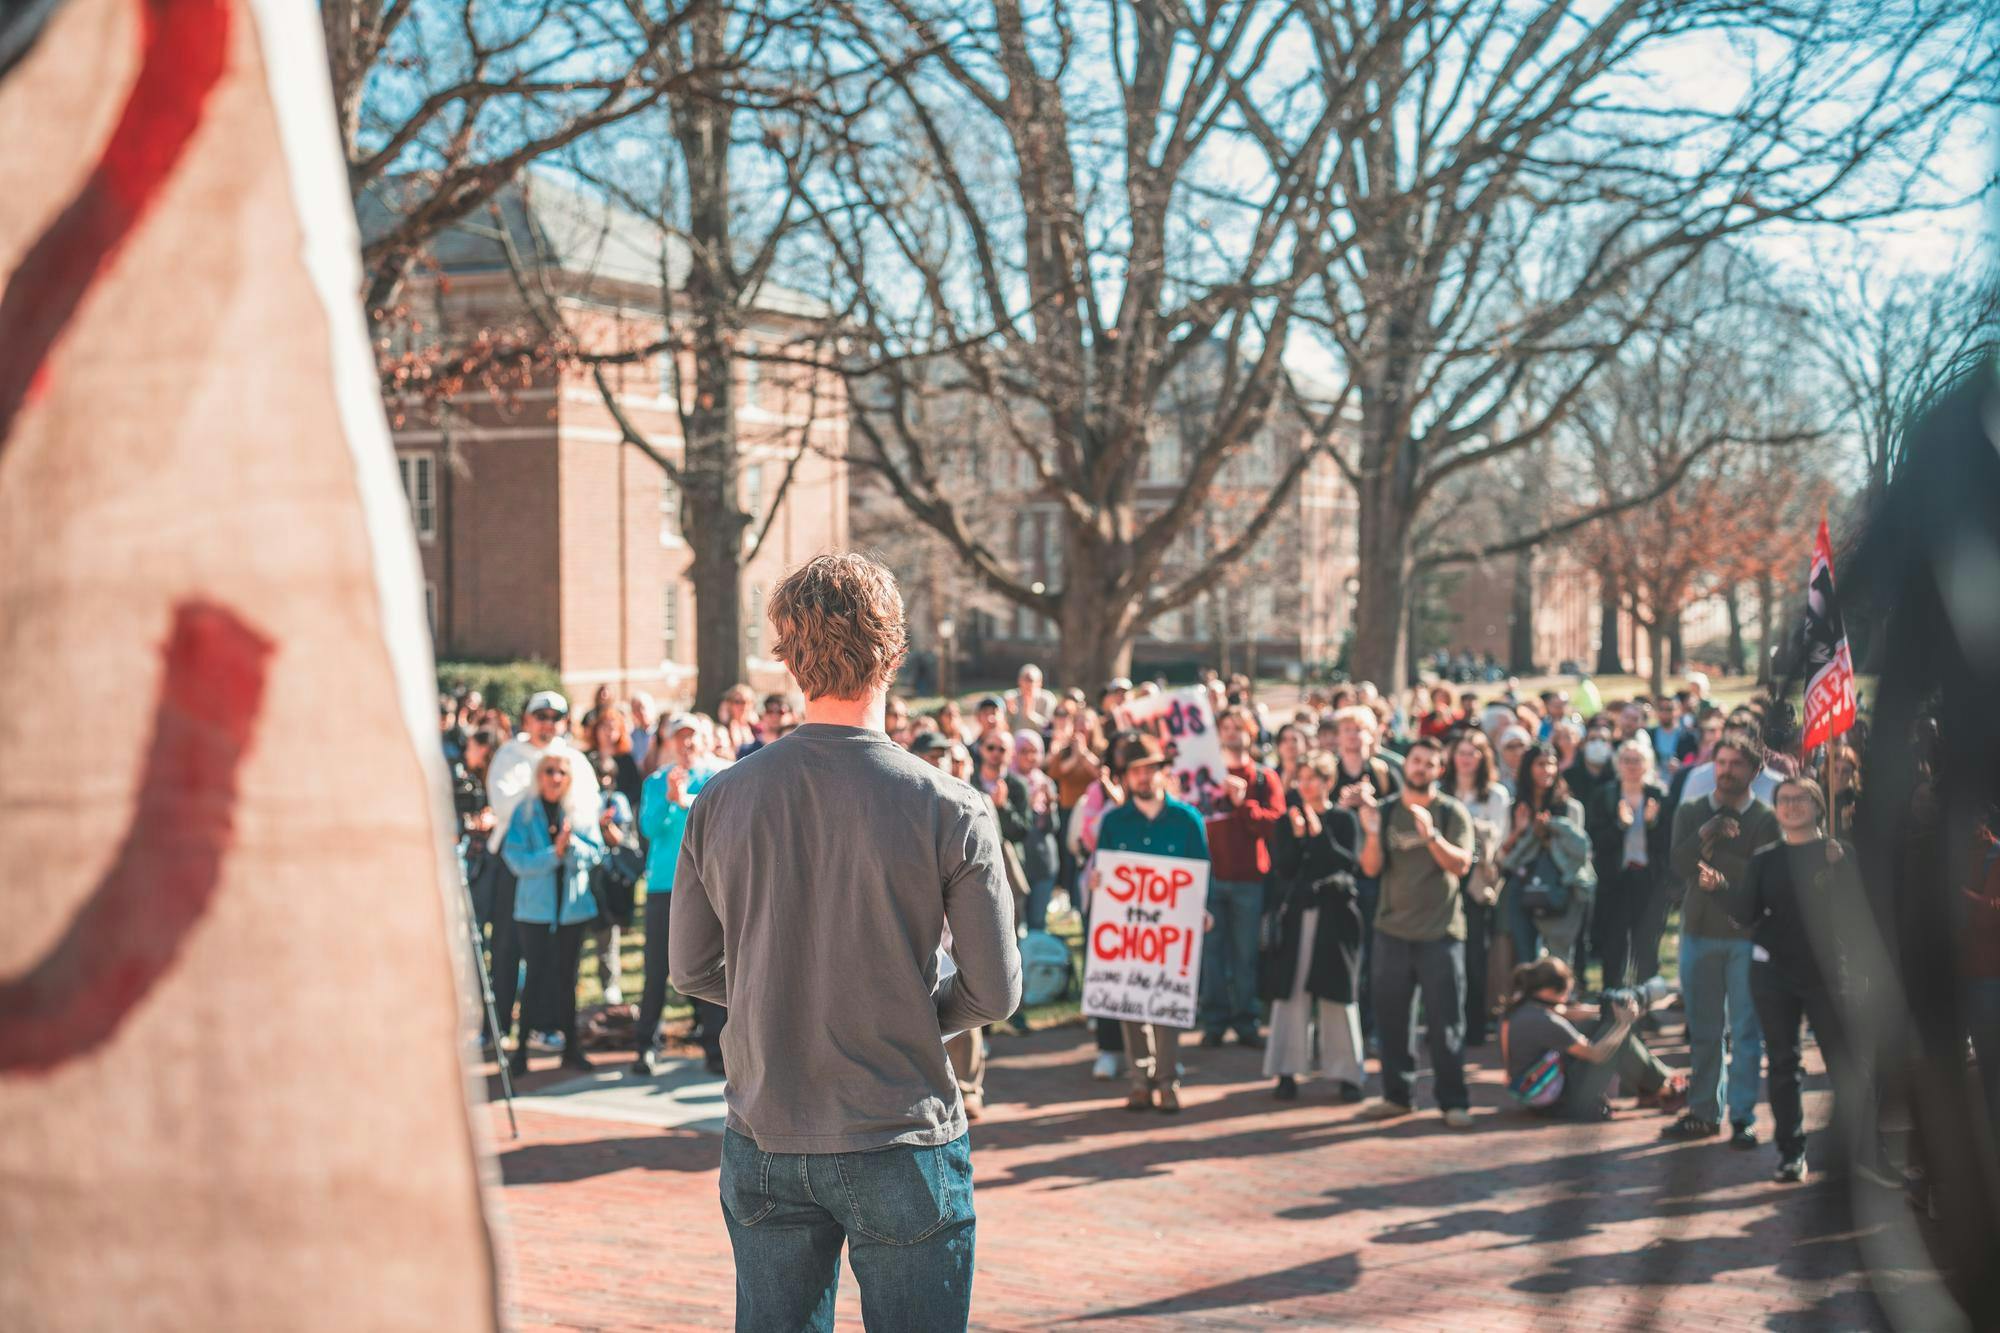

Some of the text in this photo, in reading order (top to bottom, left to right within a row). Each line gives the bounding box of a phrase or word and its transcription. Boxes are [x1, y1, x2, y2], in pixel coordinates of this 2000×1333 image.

[1106, 864, 1194, 909] STOP
[1126, 906, 1162, 923] the
[1093, 922, 1193, 977] CHOP!
